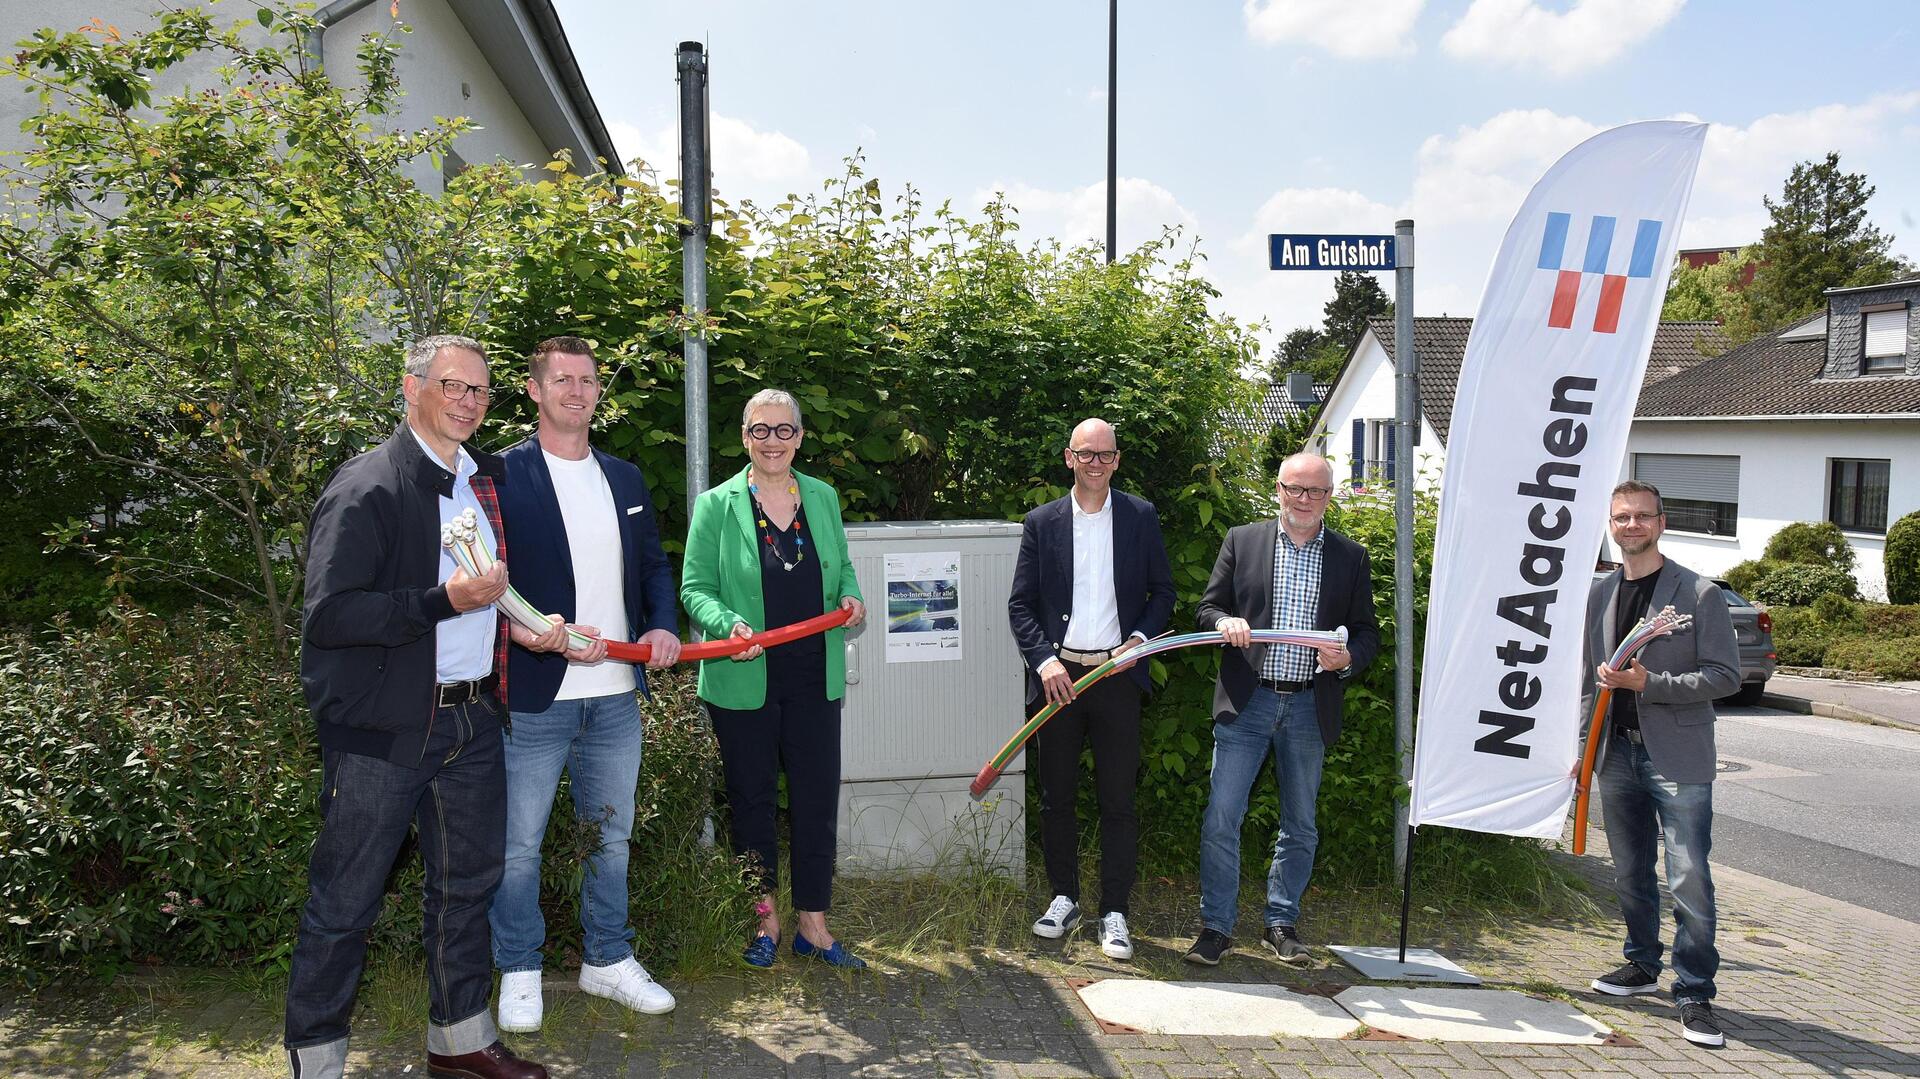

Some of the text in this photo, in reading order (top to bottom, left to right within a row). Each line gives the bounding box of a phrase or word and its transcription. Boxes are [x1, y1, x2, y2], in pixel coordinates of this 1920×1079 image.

[1282, 239, 1385, 266] Am Gutshof
[1473, 375, 1598, 760] NetAachen
